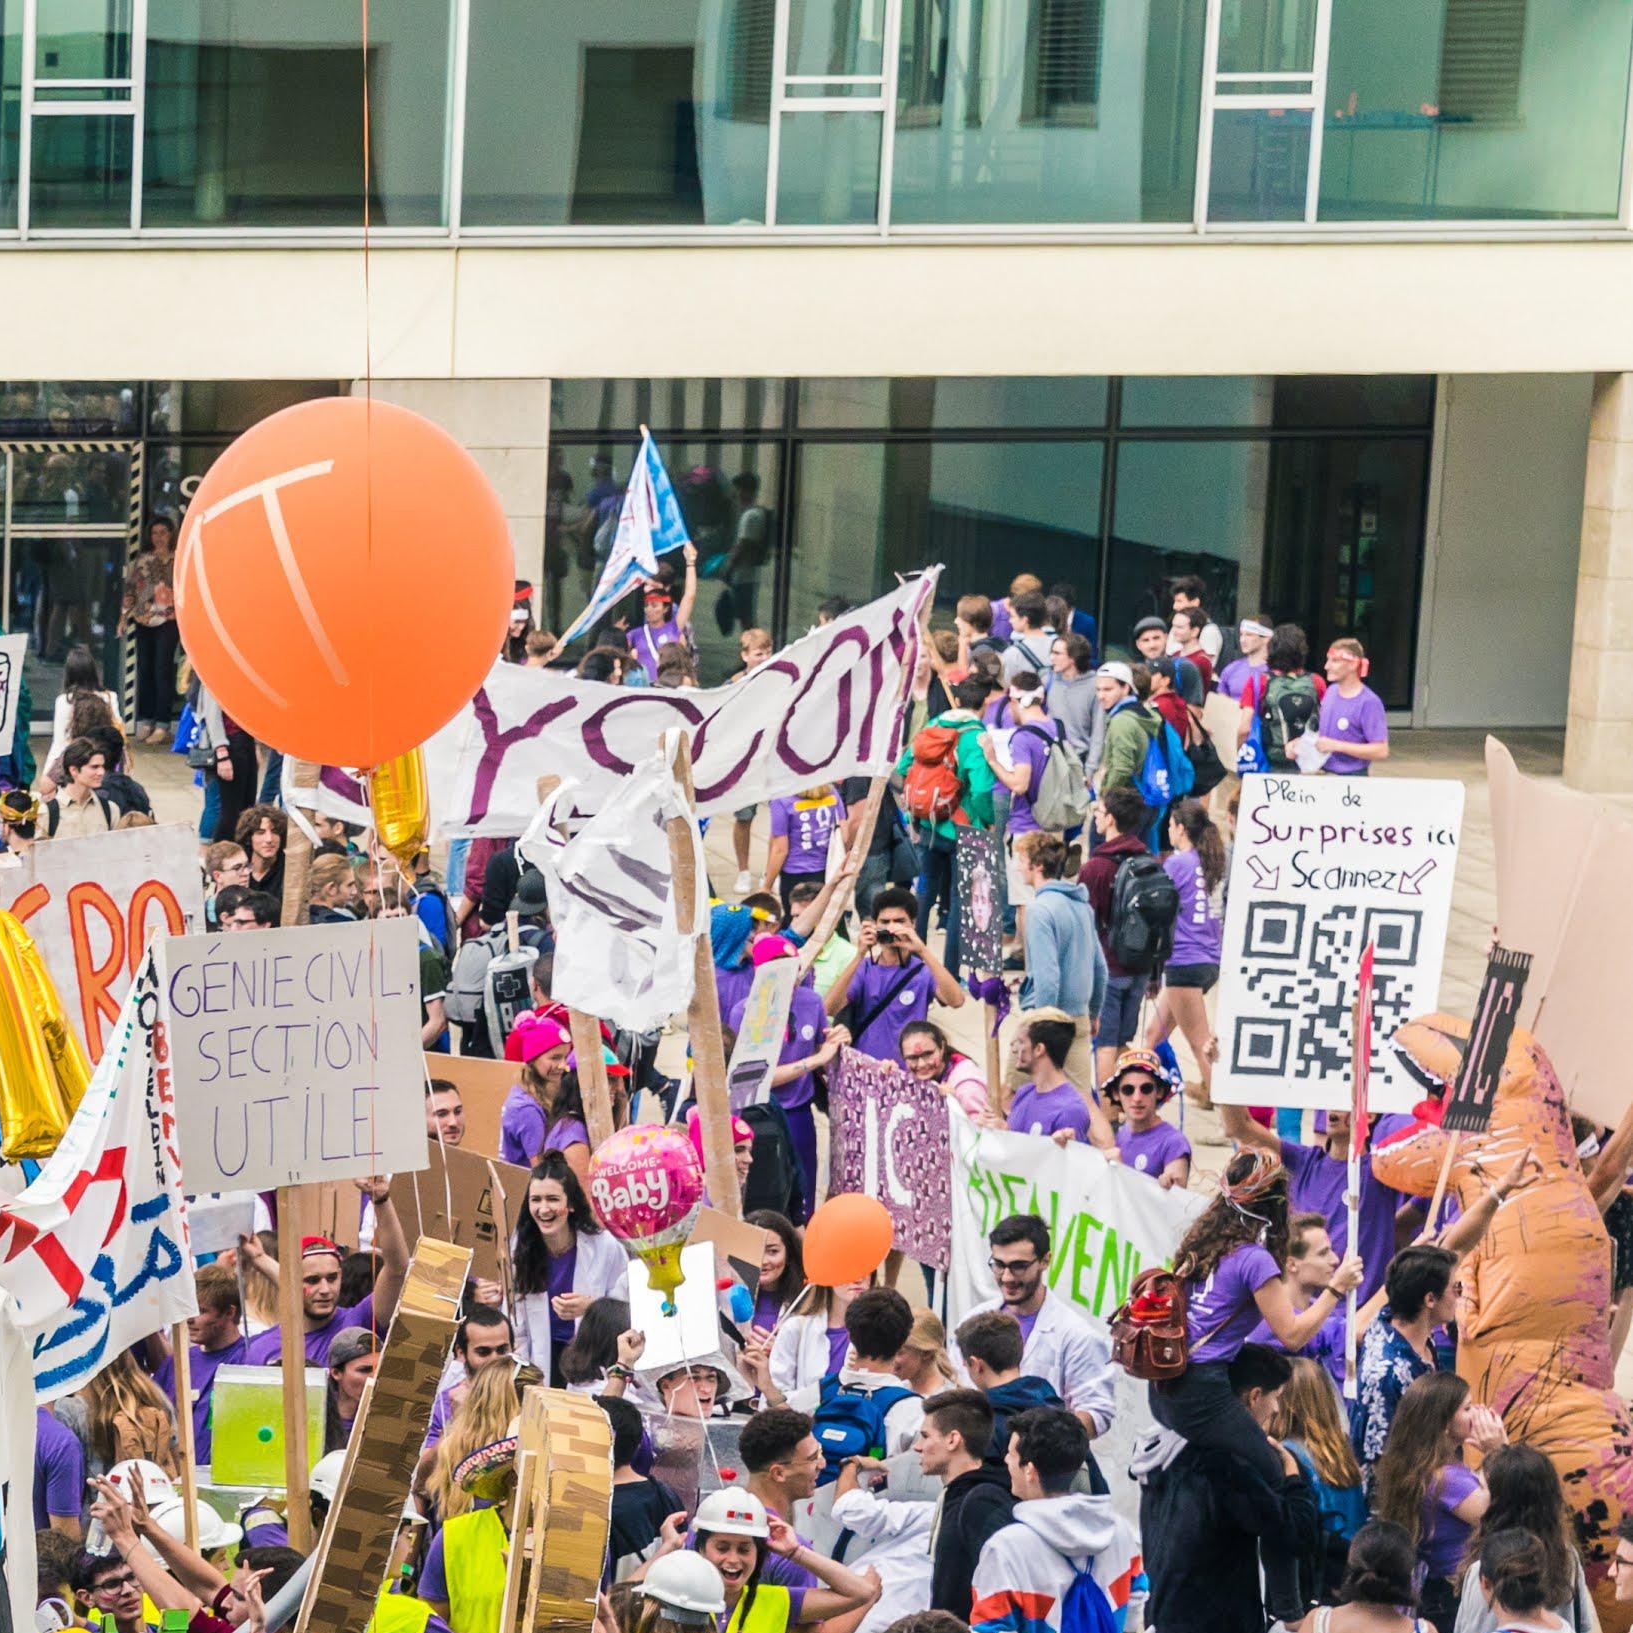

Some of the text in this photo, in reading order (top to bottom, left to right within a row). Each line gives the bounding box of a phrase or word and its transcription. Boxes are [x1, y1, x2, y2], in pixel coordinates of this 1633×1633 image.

[1263, 778, 1362, 807] Plein de
[1251, 805, 1457, 855] Surprises ici
[1291, 851, 1397, 889] Scannez
[167, 941, 295, 1018] GÉNIE
[199, 1016, 380, 1083] SECTION
[213, 1087, 384, 1178] UTILE
[864, 1095, 917, 1208] IC
[590, 1168, 671, 1215] Baby
[595, 1159, 658, 1178] WELCOME
